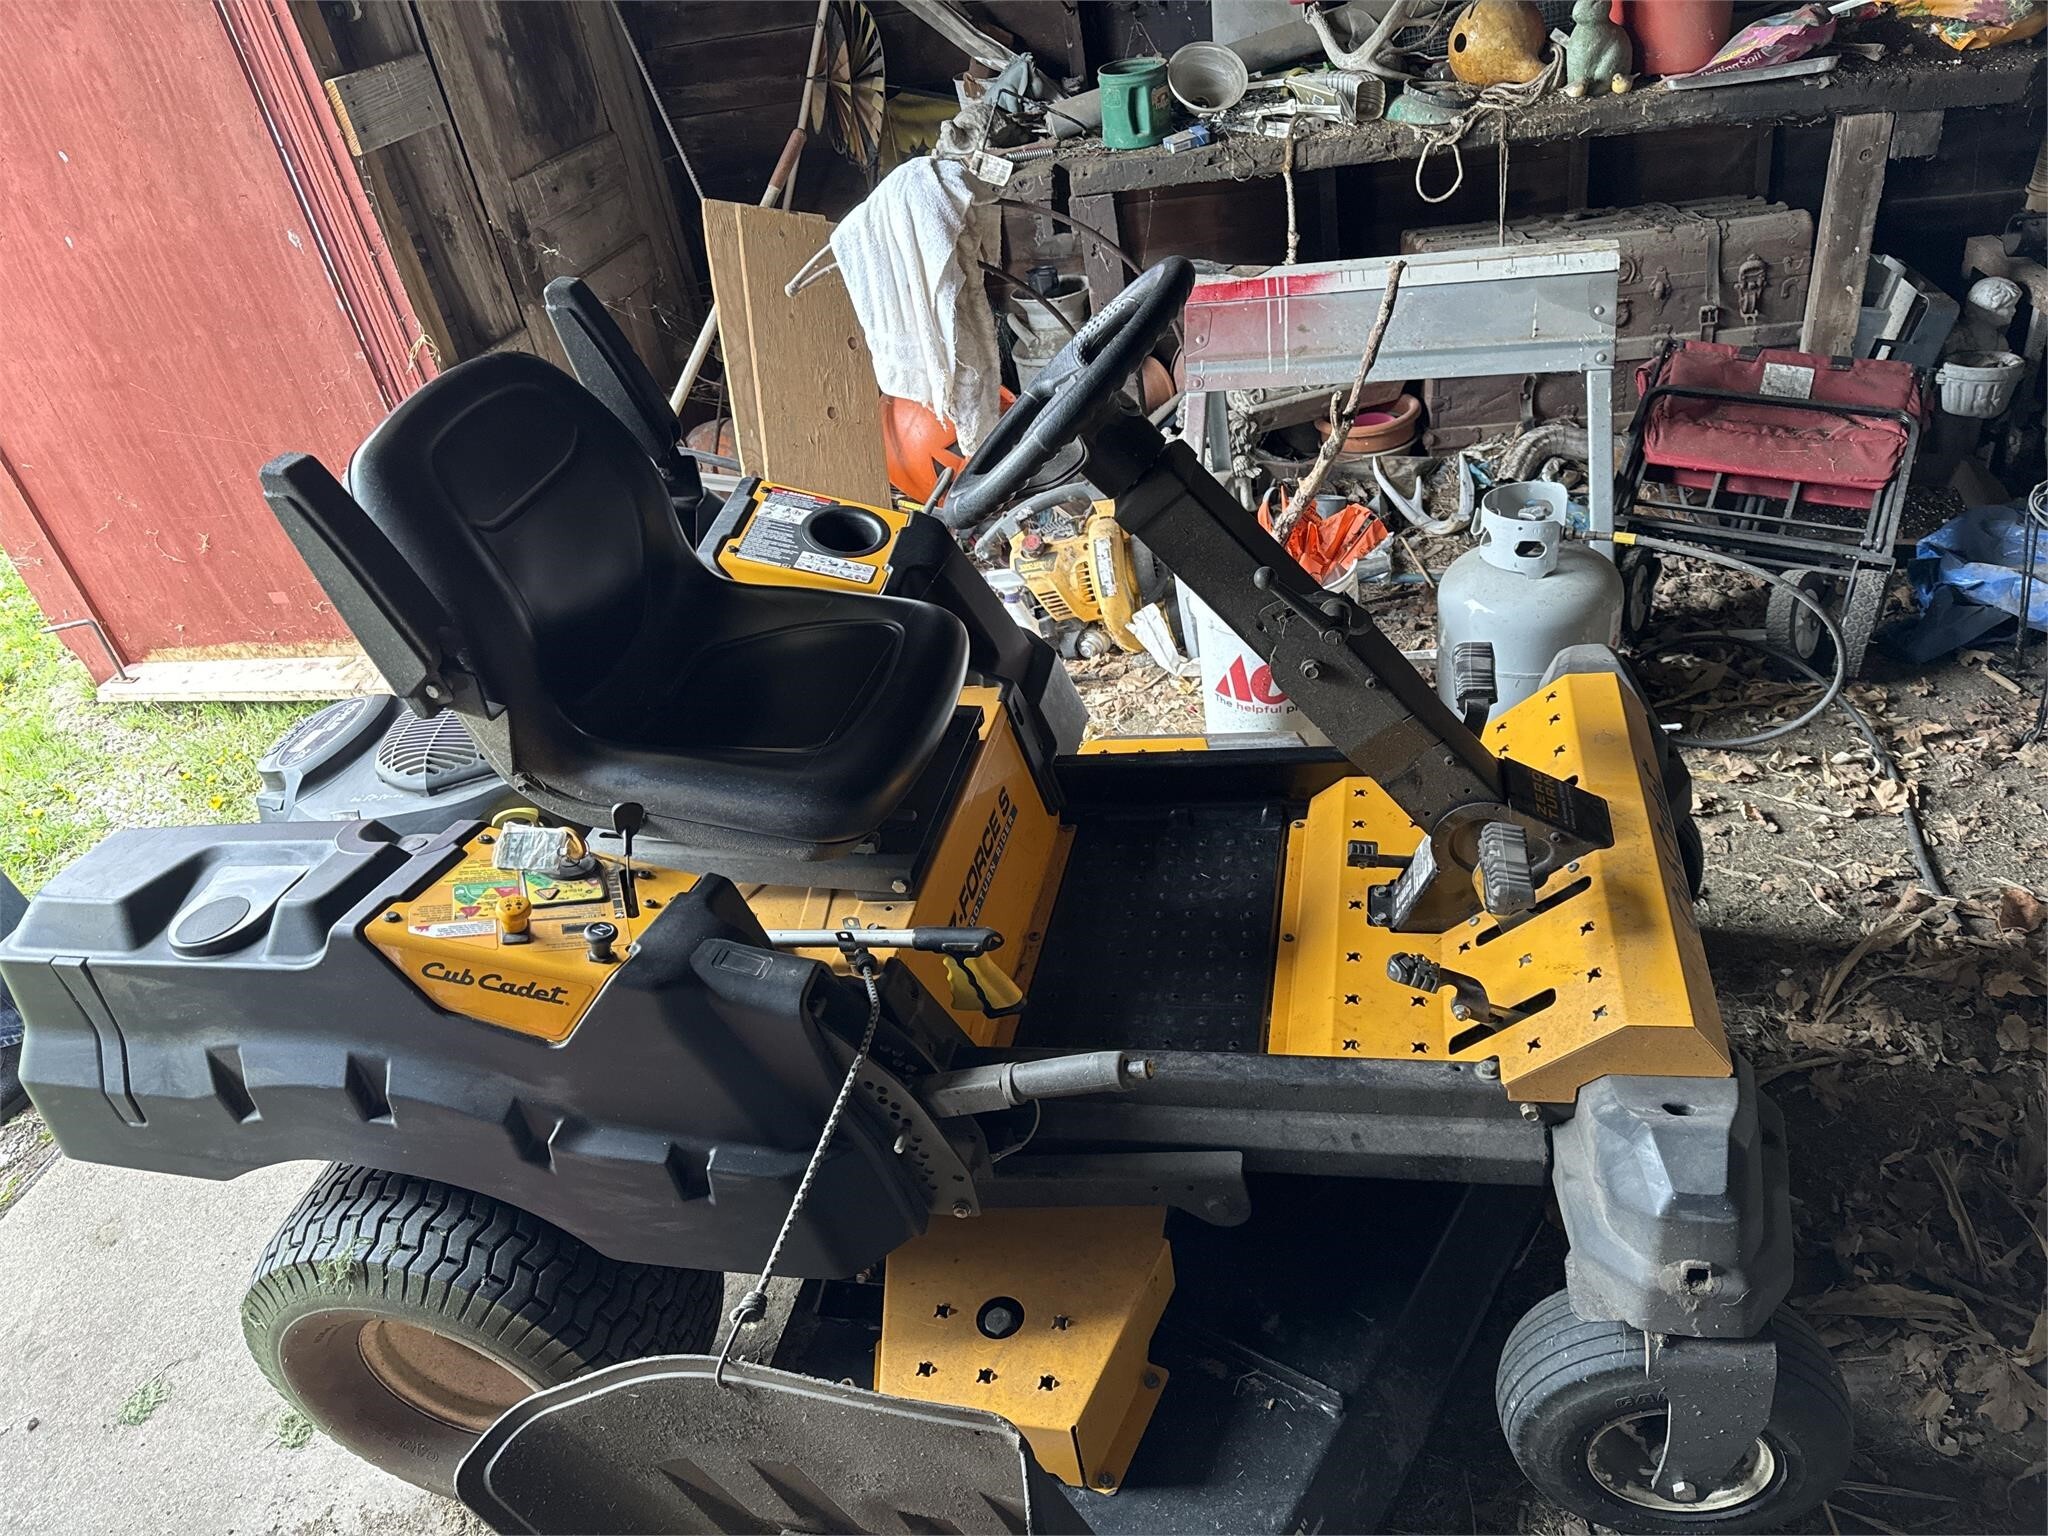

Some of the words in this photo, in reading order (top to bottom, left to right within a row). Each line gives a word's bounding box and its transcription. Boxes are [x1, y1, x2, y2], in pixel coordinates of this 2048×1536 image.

[1739, 51, 1762, 67] Soil
[1215, 654, 1290, 705] AC
[1215, 693, 1232, 708] The
[1236, 702, 1282, 715] helpful
[998, 785, 1011, 818] S
[1544, 775, 1560, 818] TURN
[968, 862, 999, 928] RO-TURN
[995, 815, 1015, 858] RIDER
[421, 961, 475, 986] Cub
[478, 973, 568, 1005] Cadet
